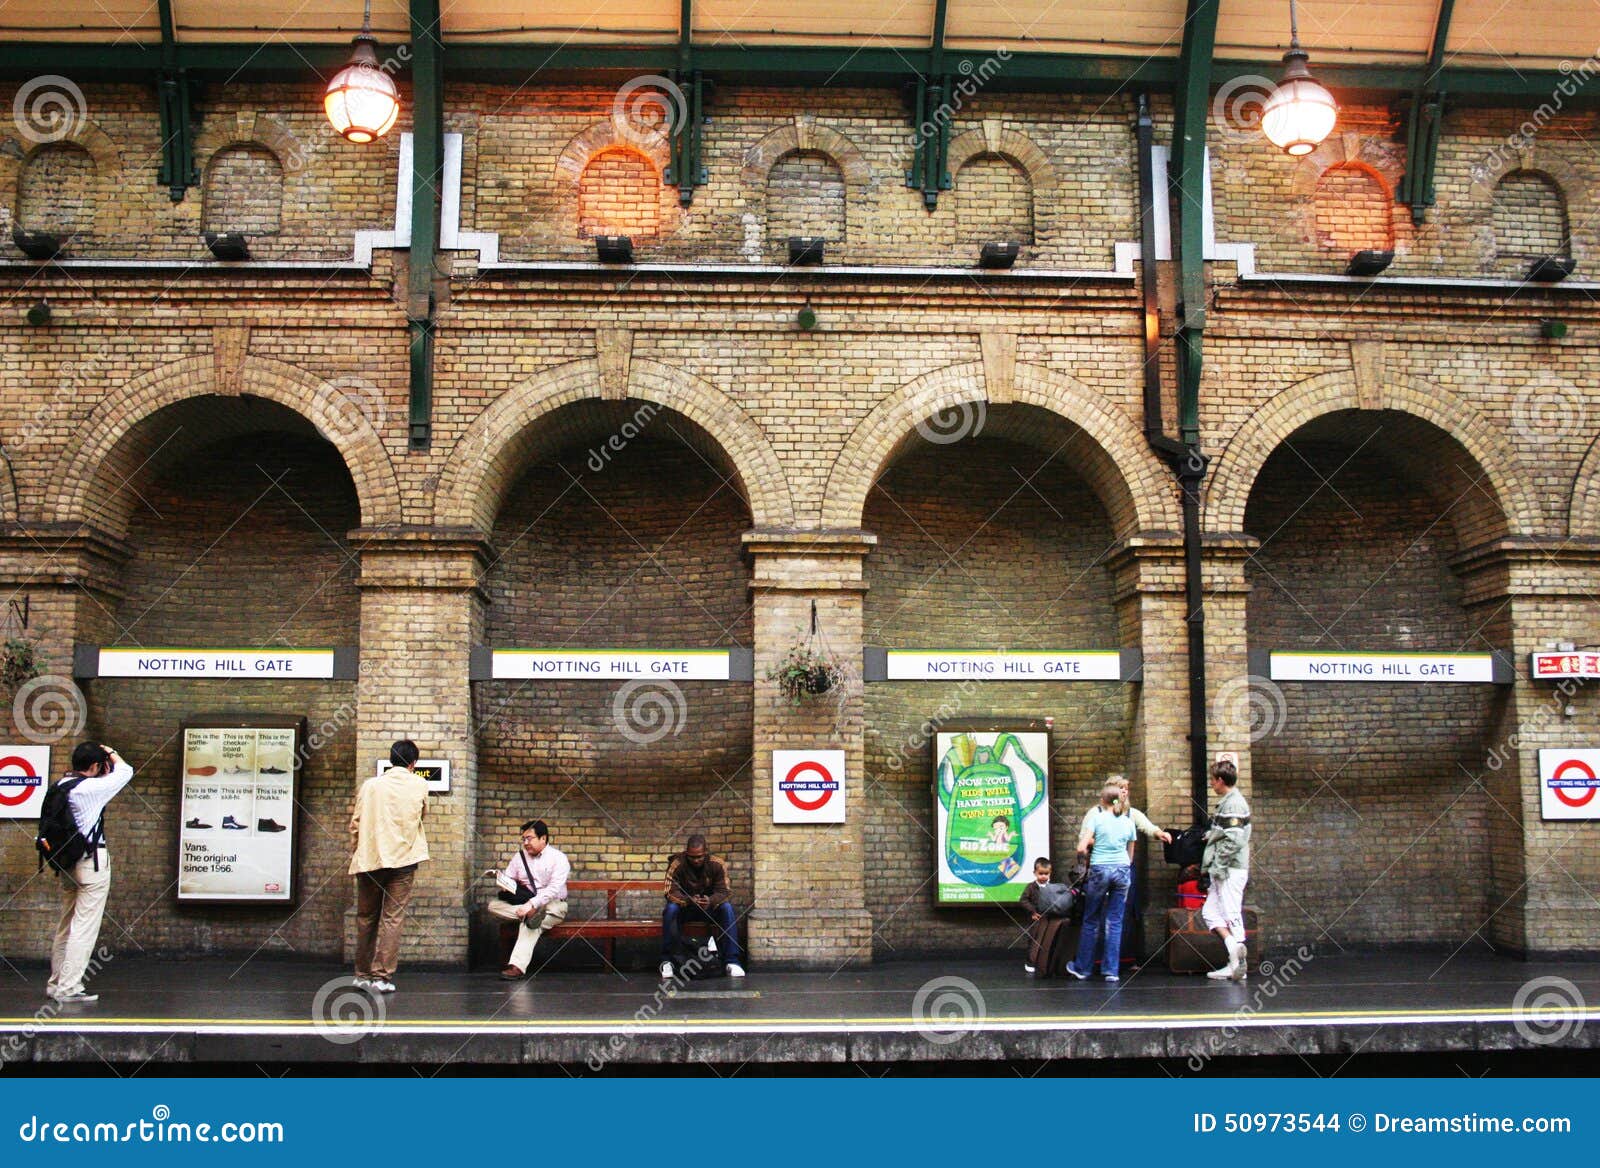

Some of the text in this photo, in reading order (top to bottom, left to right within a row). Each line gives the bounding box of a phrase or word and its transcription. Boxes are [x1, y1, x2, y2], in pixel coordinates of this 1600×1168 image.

[138, 659, 293, 671] NOTTING HILL GATE
[533, 661, 689, 673] NOTTING HILL GATE
[927, 661, 1081, 673] NOTTING HILL GATE
[1309, 663, 1455, 676] NOTTING HILL GATE
[958, 776, 1012, 787] NOW YOUR
[985, 787, 1010, 796] WILL
[957, 797, 1016, 808] HAVE THEIR
[959, 808, 1014, 818] OWN ZONE
[185, 843, 209, 852] Vans.
[184, 853, 237, 865] The original
[184, 864, 234, 873] since 1966.
